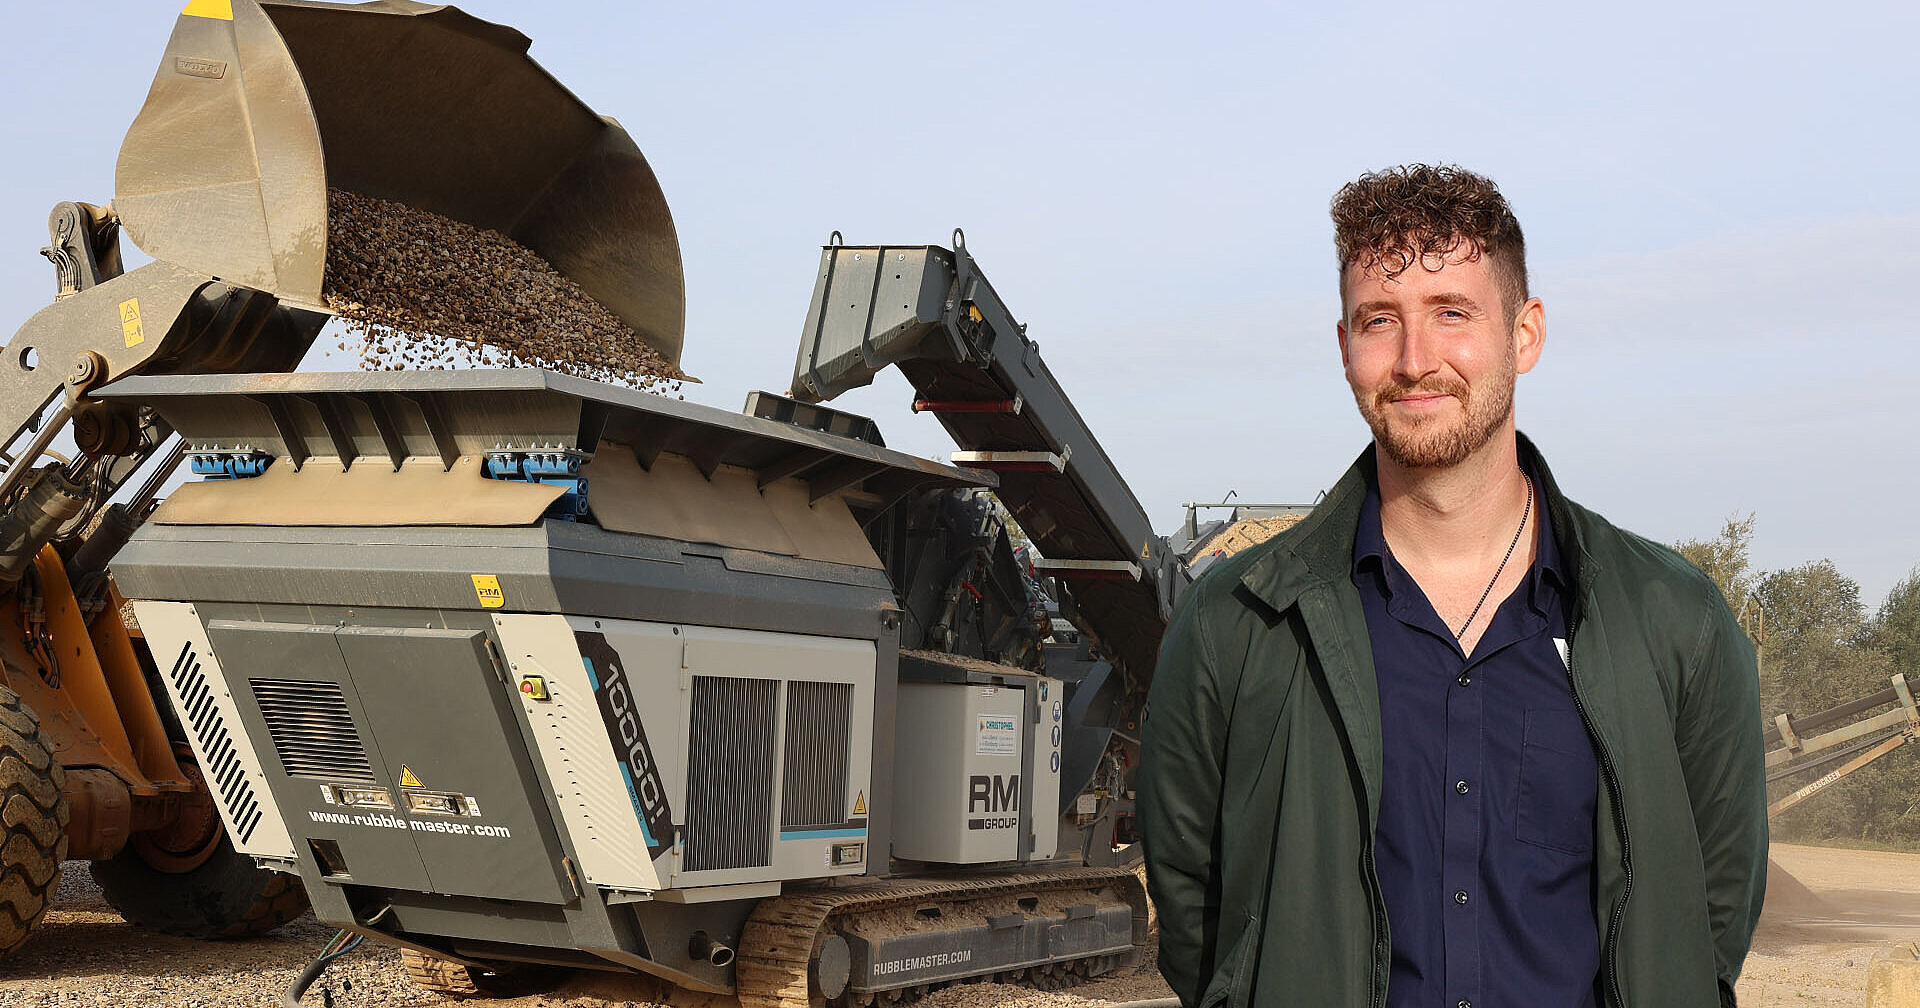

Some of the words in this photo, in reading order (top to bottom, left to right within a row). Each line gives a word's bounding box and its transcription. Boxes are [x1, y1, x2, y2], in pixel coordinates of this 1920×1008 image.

[604, 663, 665, 824] 100GO!
[969, 775, 1019, 812] RM
[985, 817, 1017, 830] GROUP
[873, 949, 971, 976] RUBBLEMASTER.COM
